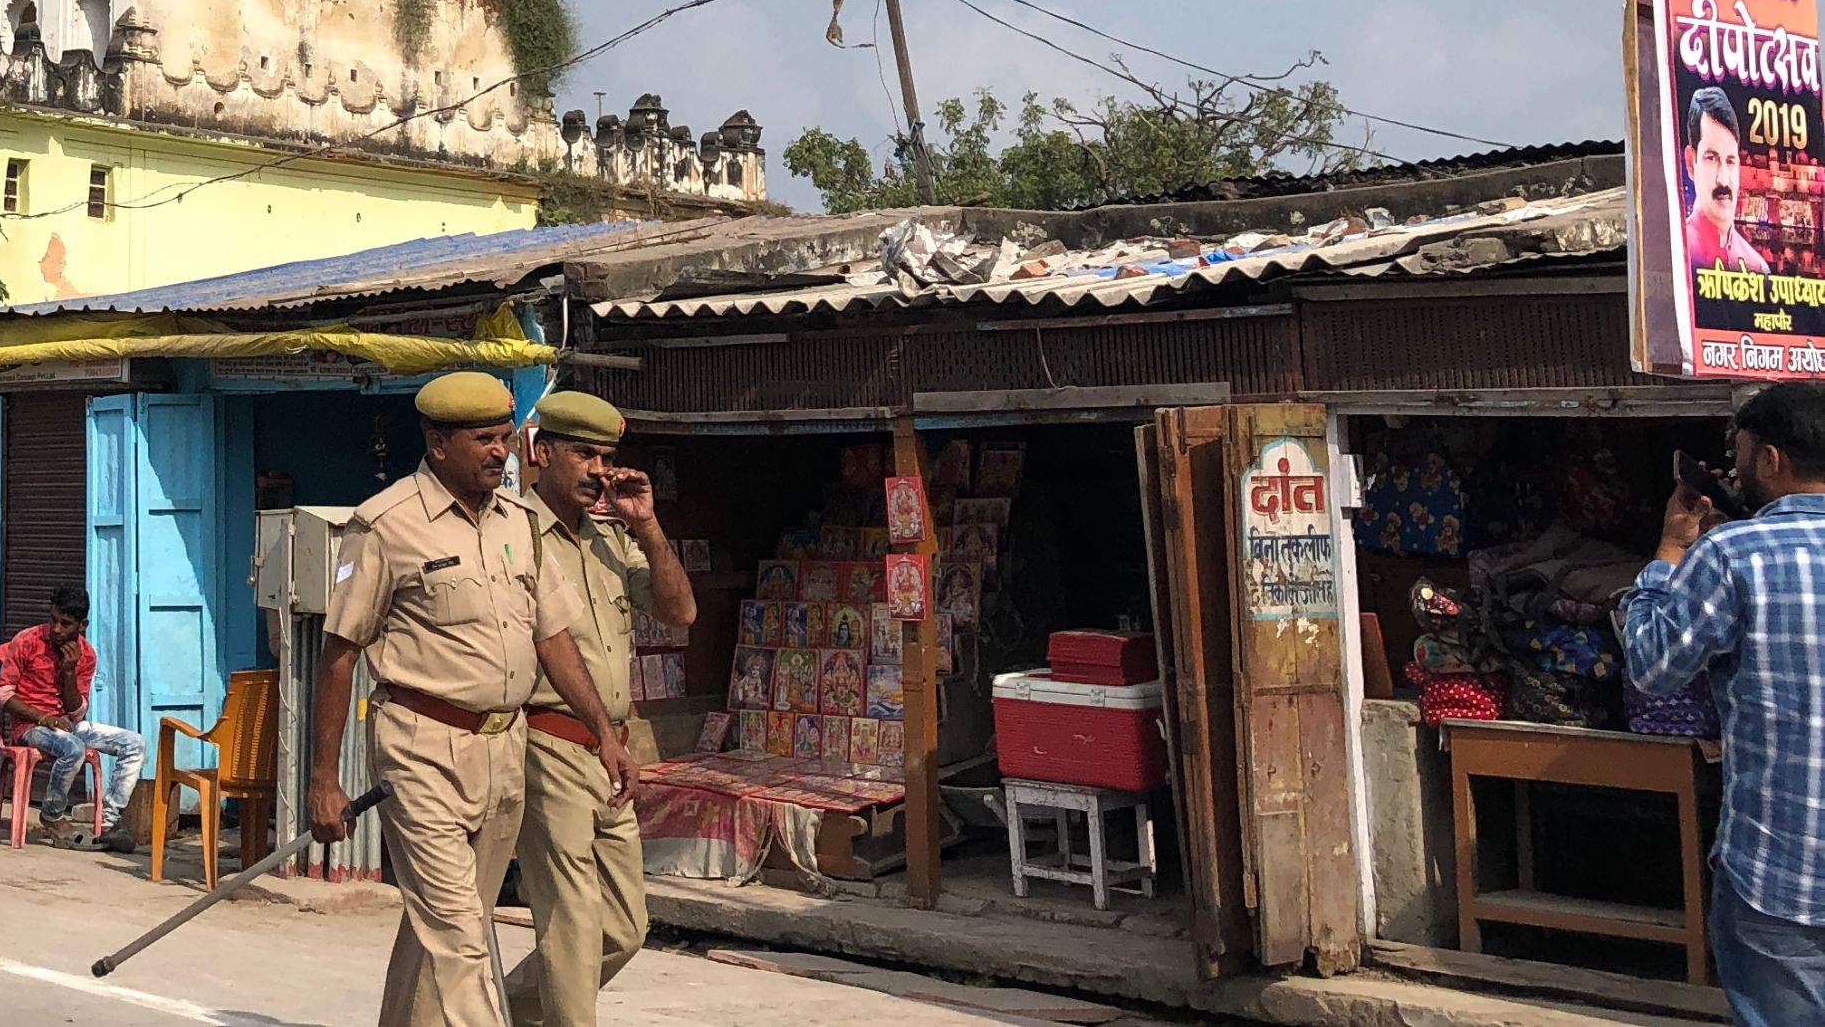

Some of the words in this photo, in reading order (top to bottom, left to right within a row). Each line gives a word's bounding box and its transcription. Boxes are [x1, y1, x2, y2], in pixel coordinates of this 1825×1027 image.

[1748, 98, 1809, 150] 2019
[1696, 256, 1766, 304] ऋषिकेश
[1753, 308, 1793, 331] महापौर
[1701, 340, 1740, 370] नगर
[1739, 333, 1785, 372] निगम
[1250, 457, 1325, 525] दांत
